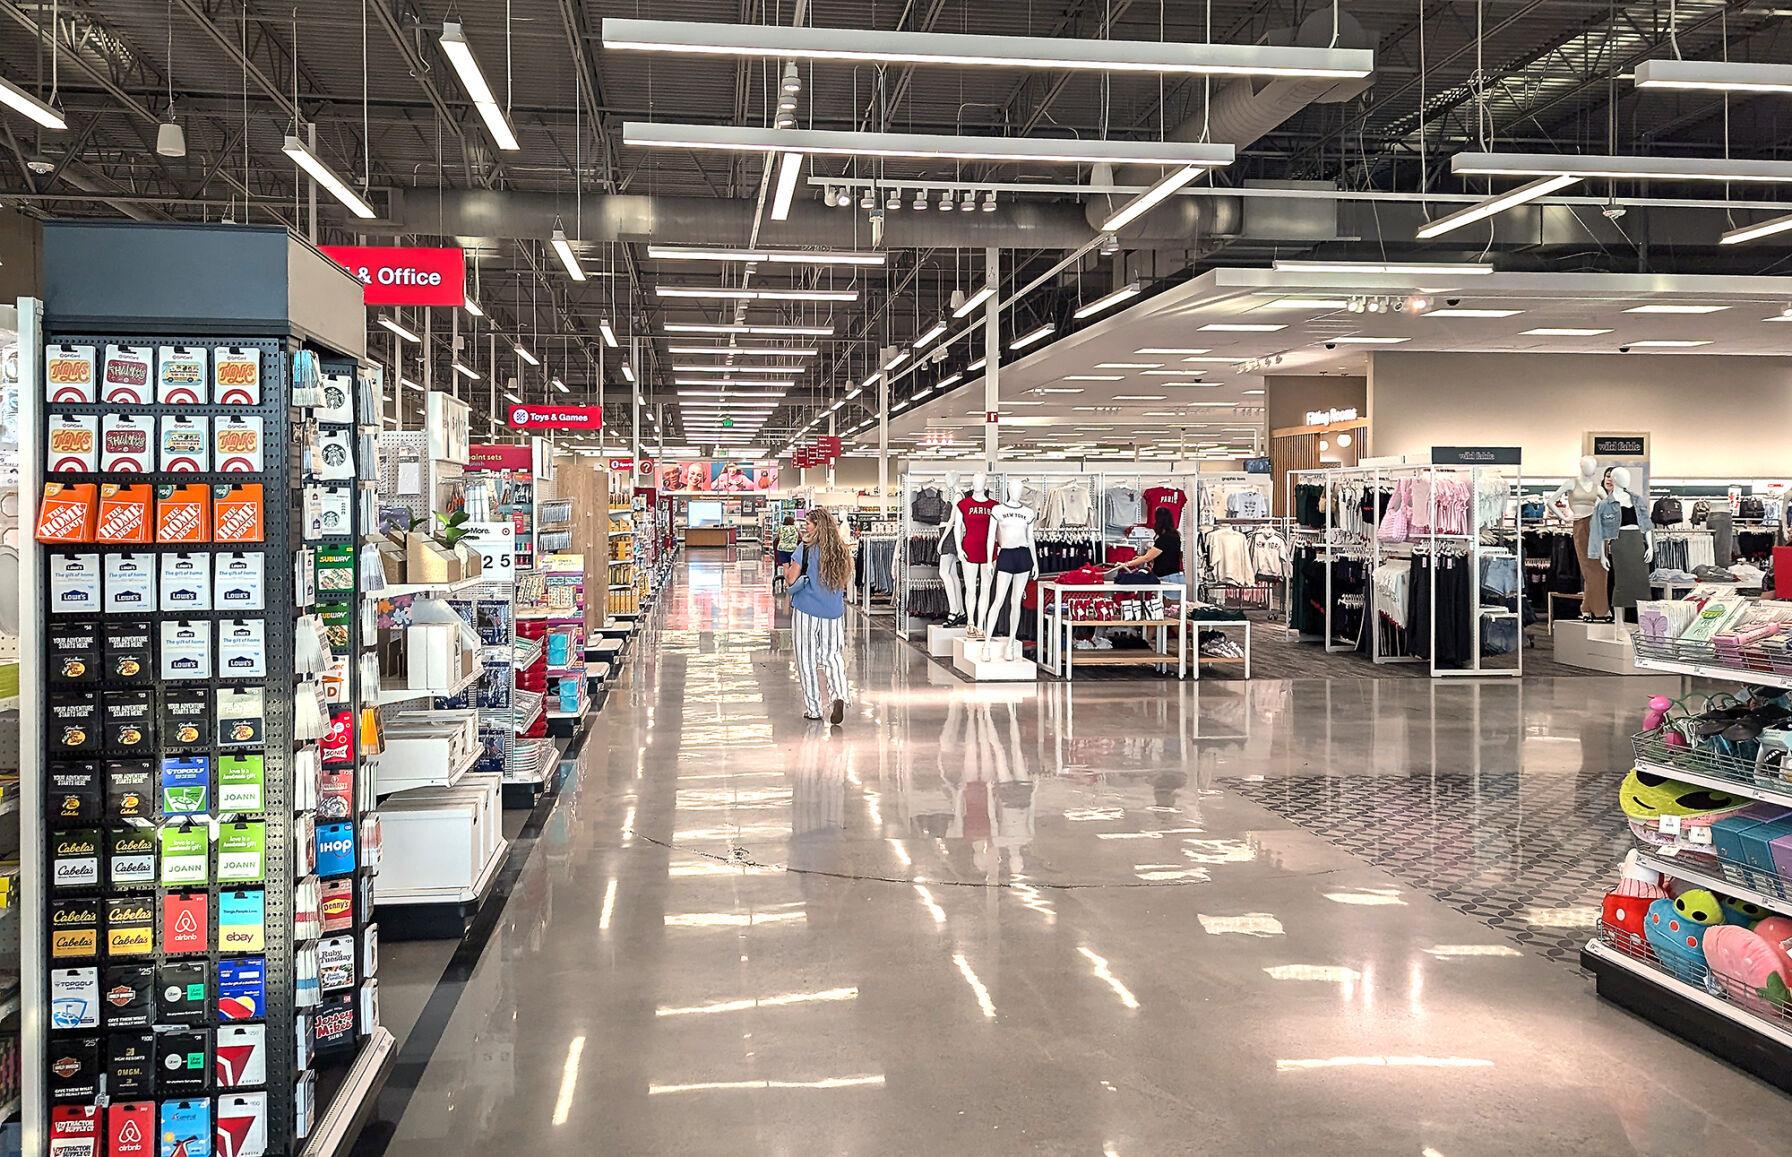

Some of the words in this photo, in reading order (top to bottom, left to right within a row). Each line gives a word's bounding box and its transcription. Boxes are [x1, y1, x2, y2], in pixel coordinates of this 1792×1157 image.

[358, 267, 372, 284] &
[377, 266, 442, 286] Office
[530, 412, 550, 422] Toys
[550, 413, 558, 421] &
[558, 413, 589, 422] Games
[46, 504, 67, 520] THE
[104, 505, 124, 521] THE
[163, 506, 181, 522] THE
[220, 506, 238, 521] THE
[40, 502, 87, 537] HOME
[99, 502, 144, 538] HOME
[159, 503, 200, 540] HOME
[217, 502, 257, 540] HOME
[319, 555, 351, 563] SUBWAY
[483, 555, 494, 569] 2
[500, 553, 511, 568] 5
[320, 611, 347, 619] UBWAY
[326, 686, 338, 698] D
[325, 748, 345, 757] SONIC
[224, 793, 256, 801] JOANN
[57, 842, 95, 853] Cabela's
[115, 839, 152, 850] Cabela's
[319, 839, 352, 854] IHOP
[57, 865, 94, 876] Cabela's
[114, 862, 151, 873] Cabela's
[168, 864, 202, 873] JOANN
[223, 861, 256, 869] JOANN
[323, 901, 349, 913] Denny's
[53, 910, 96, 922] Cabela's
[108, 908, 152, 921] Cabela's
[56, 936, 93, 948] Cabela's
[111, 934, 149, 946] Cabela's
[174, 933, 198, 942] airbnb
[226, 931, 254, 944] ebay
[319, 953, 352, 964] Tuesday
[321, 949, 342, 958] Ruby
[315, 1008, 354, 1027] Jersey
[327, 1032, 344, 1042] SUBS
[118, 1143, 142, 1152] airbnb
